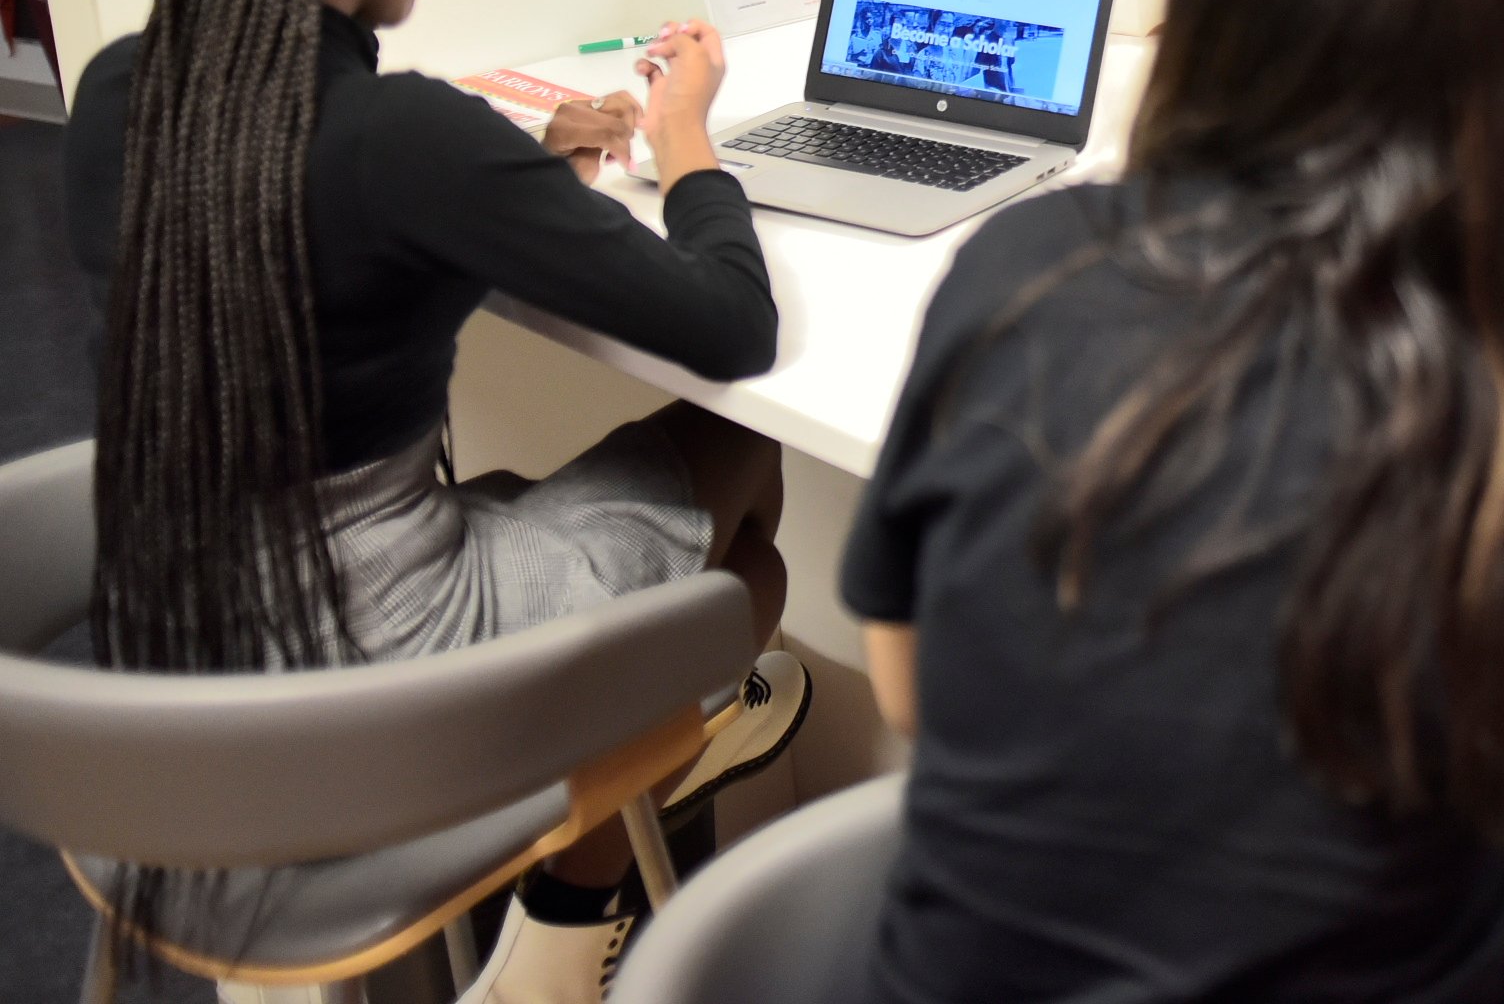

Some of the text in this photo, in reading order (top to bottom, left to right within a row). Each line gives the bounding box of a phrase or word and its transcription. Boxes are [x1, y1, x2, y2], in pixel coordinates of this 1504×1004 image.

[891, 22, 1019, 58] Become a Scholar
[481, 69, 570, 102] BARRON'S
